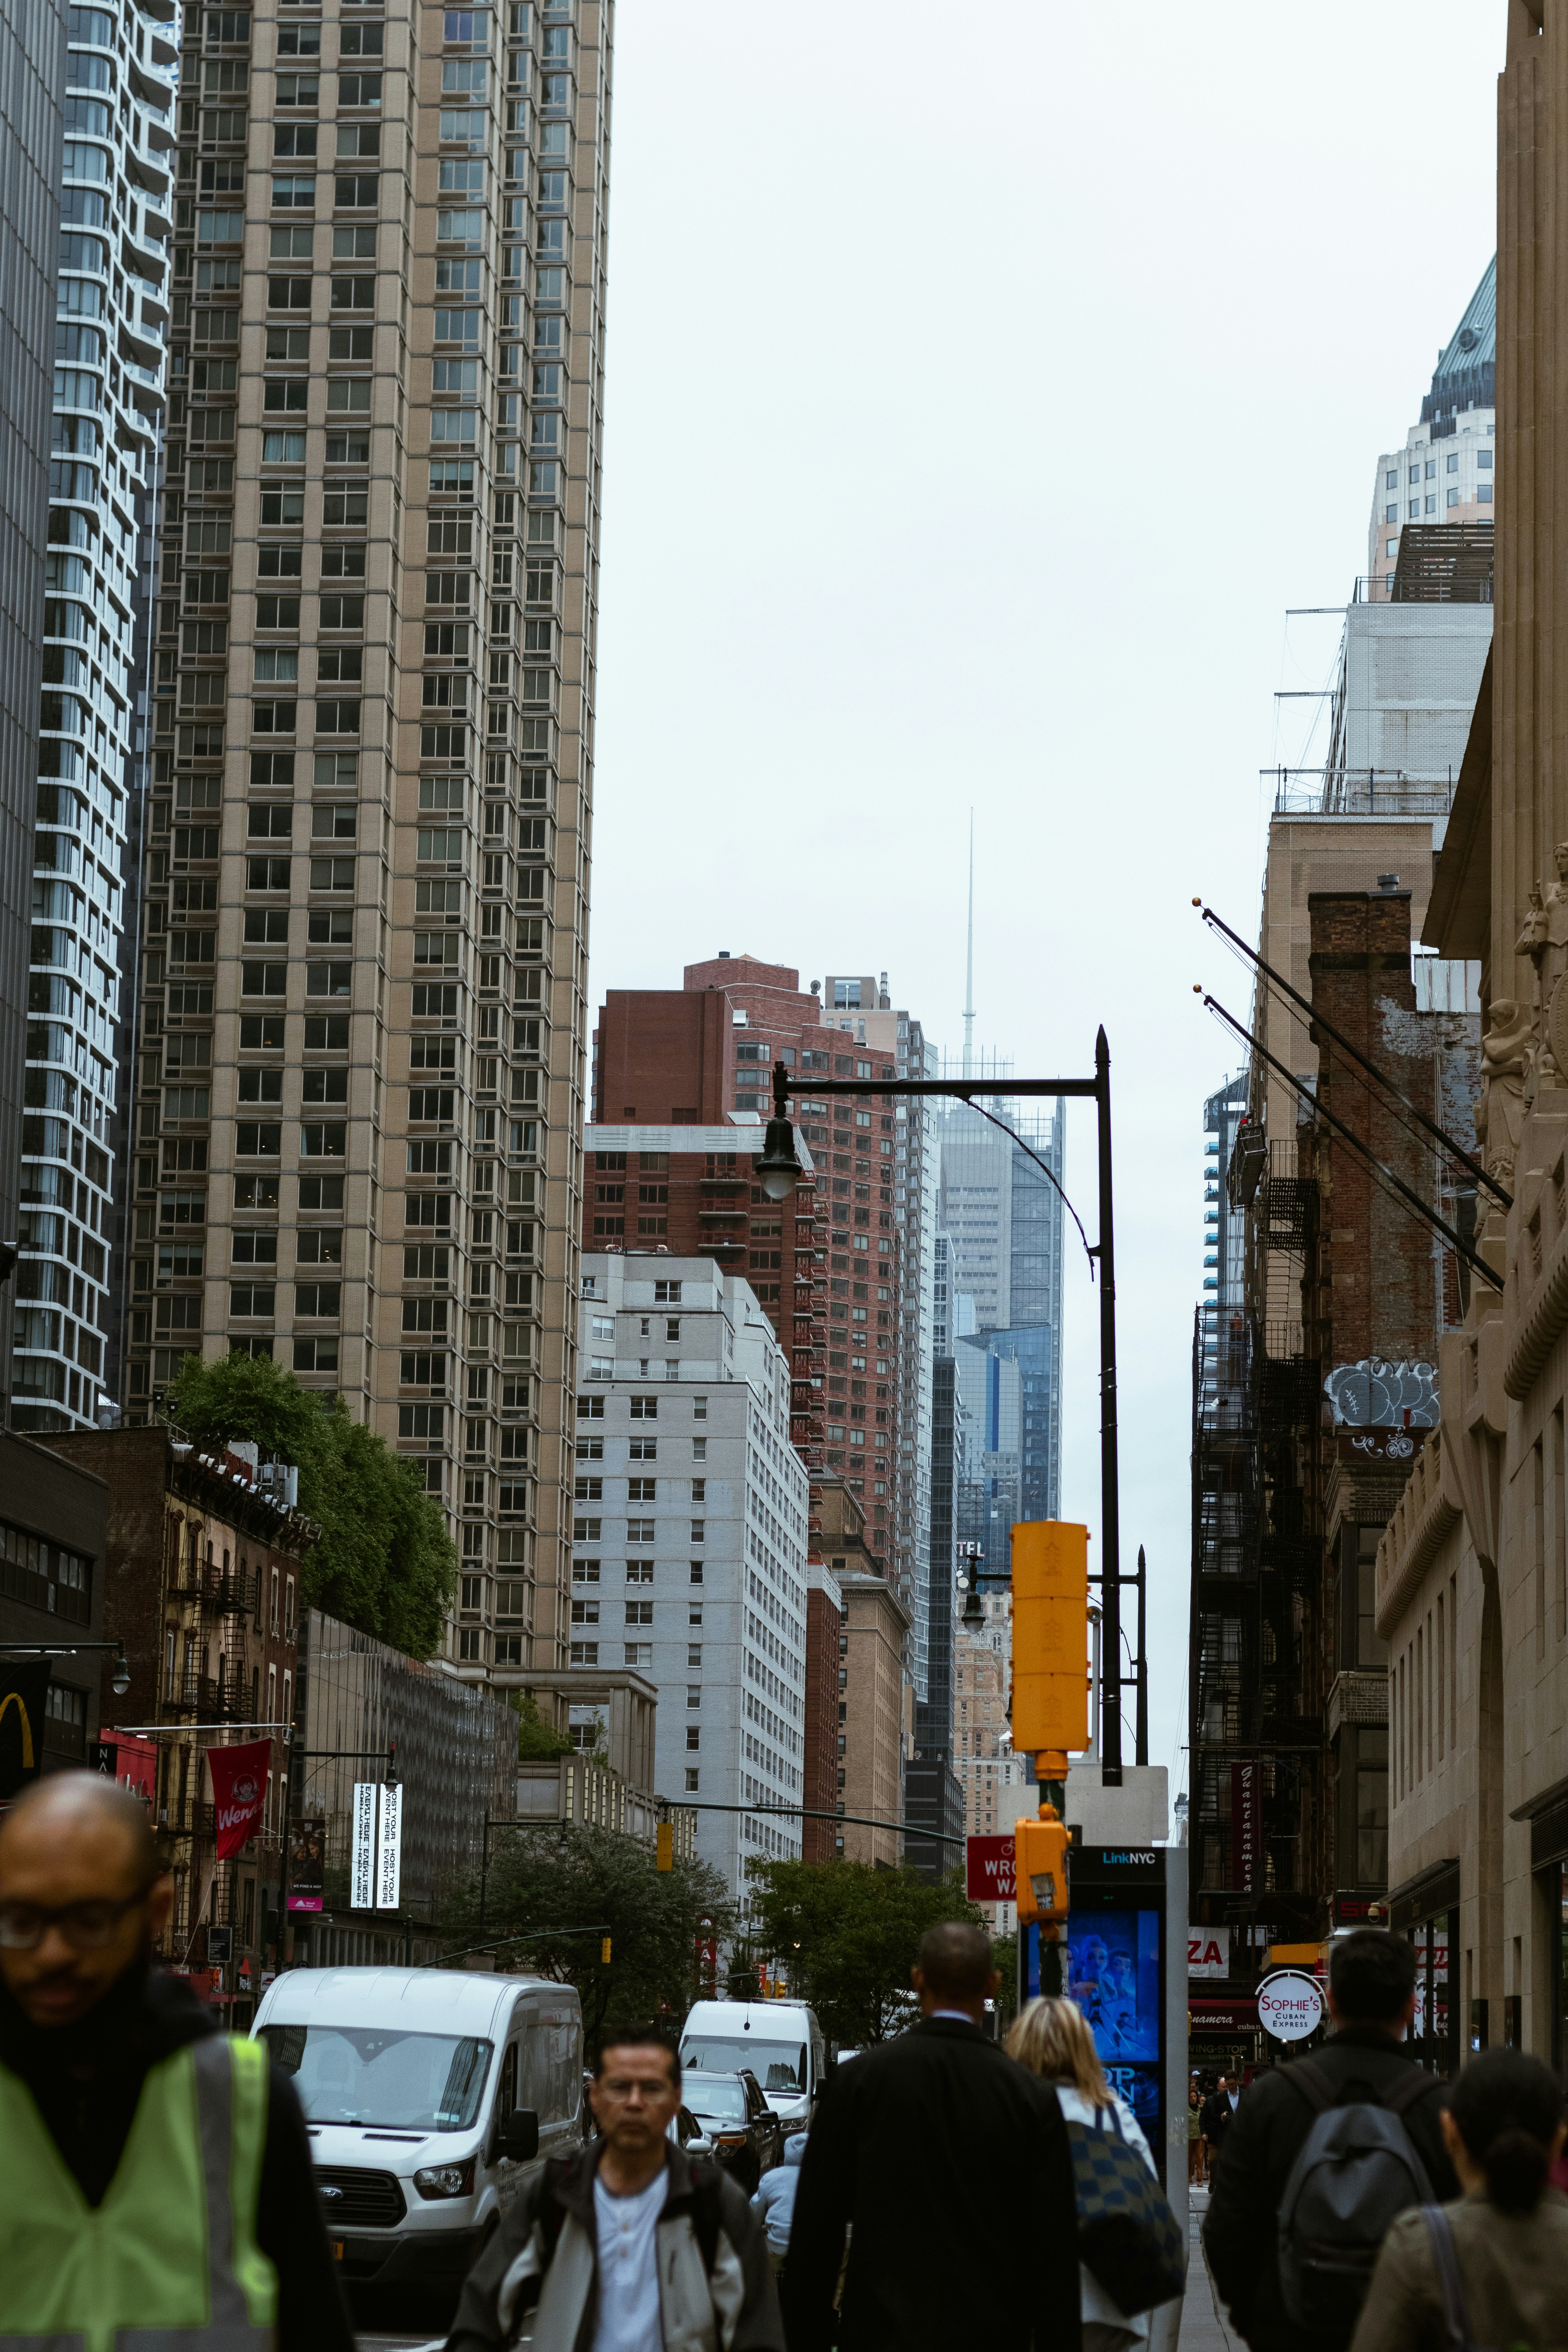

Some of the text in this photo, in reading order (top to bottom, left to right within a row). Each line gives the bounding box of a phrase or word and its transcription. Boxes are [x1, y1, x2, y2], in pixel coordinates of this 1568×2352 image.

[956, 1541, 985, 1557] TEL
[1241, 1766, 1252, 1891] Guantanamera
[1103, 1852, 1156, 1864] LinkNYC
[1191, 2016, 1234, 2024] namera
